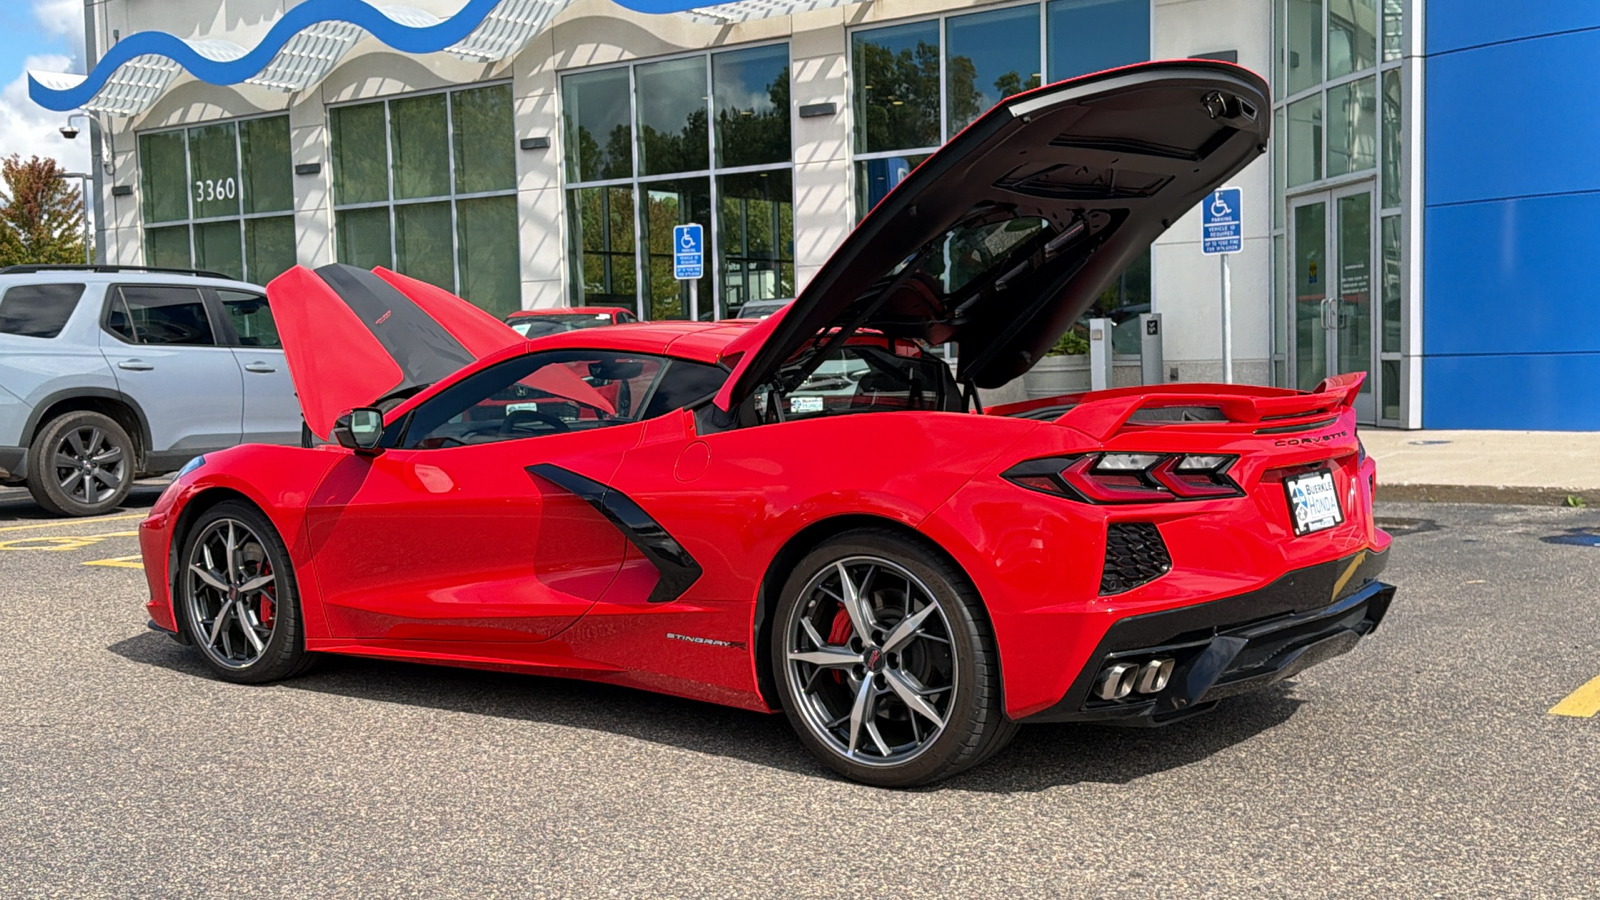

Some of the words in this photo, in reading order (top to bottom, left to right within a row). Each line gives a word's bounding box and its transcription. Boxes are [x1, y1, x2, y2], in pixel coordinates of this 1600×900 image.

[195, 177, 235, 202] 3360
[1274, 431, 1347, 447] CORVETTE
[1305, 481, 1333, 495] BUERKLE
[1308, 496, 1336, 515] HONDA
[666, 633, 731, 647] STINGRAY
